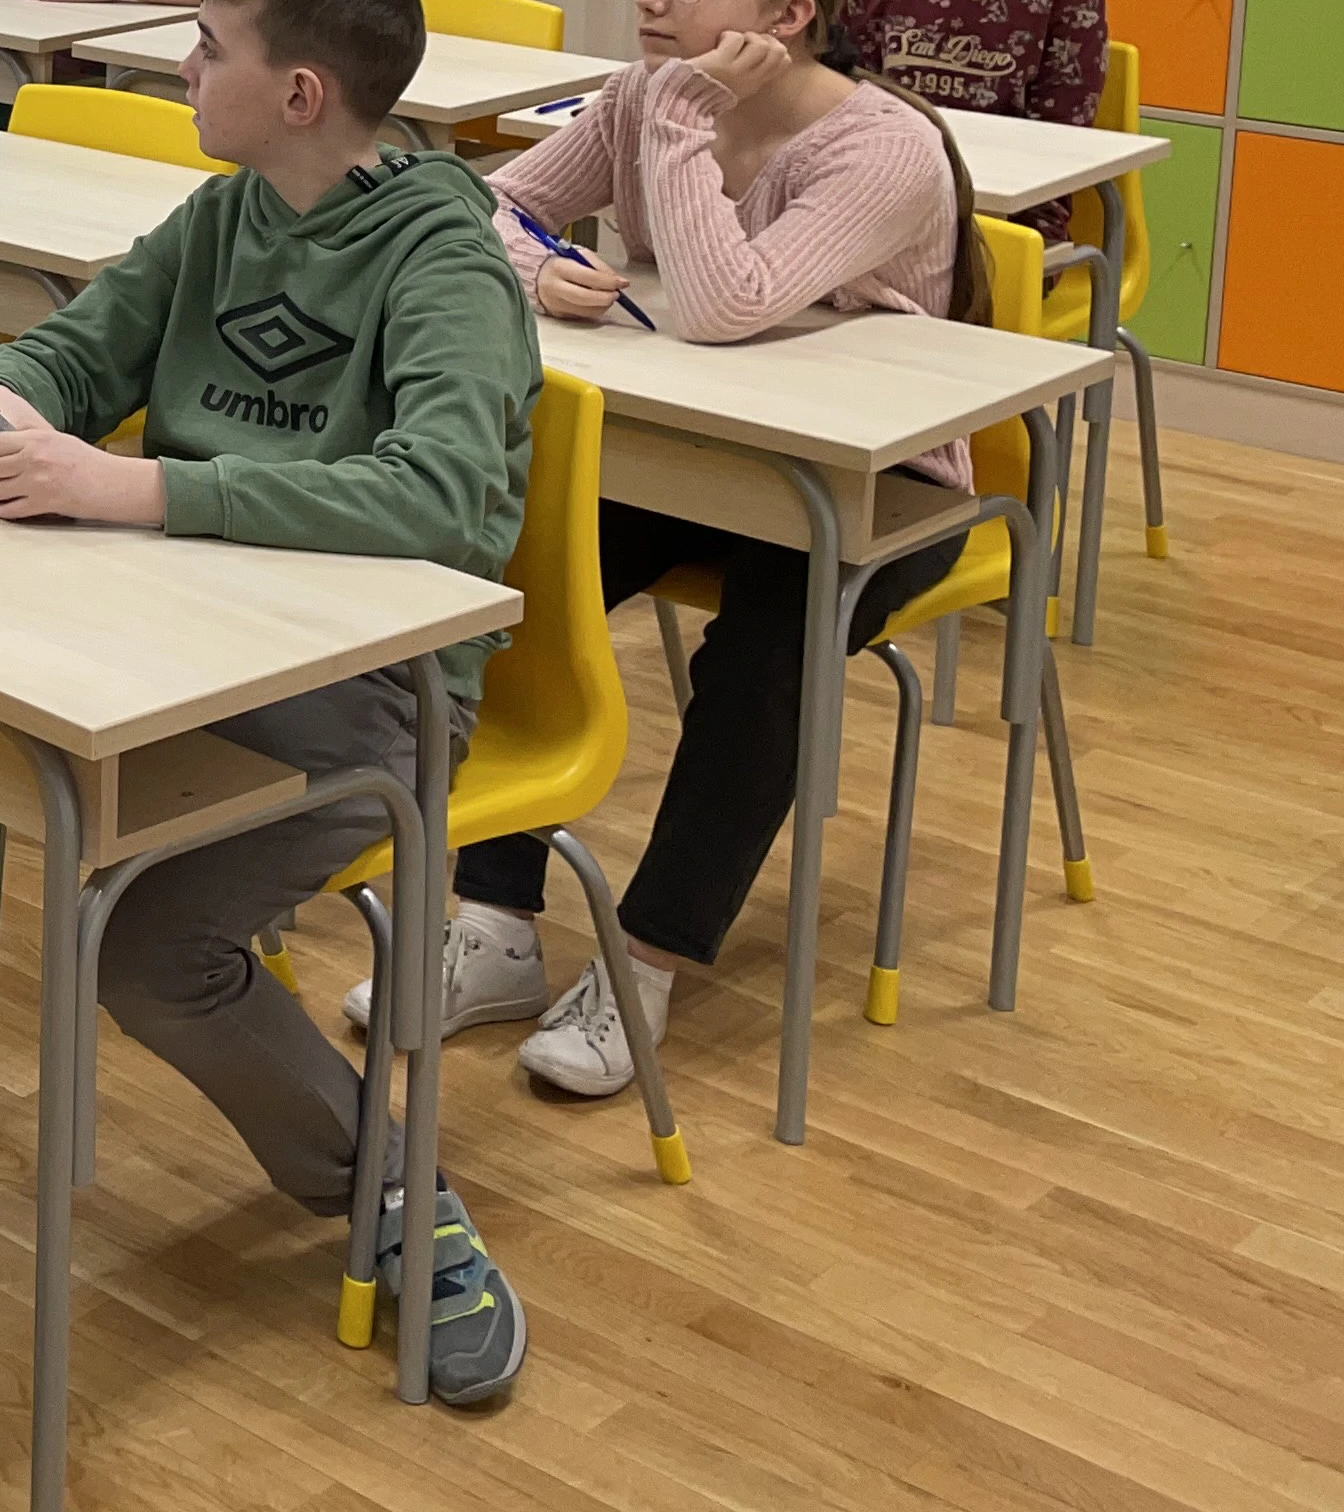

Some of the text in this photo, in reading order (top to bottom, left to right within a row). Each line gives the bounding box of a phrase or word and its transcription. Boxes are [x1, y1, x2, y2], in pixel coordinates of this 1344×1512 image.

[885, 29, 1012, 70] San Diego
[910, 70, 965, 99] 1995
[200, 382, 329, 433] umbro
